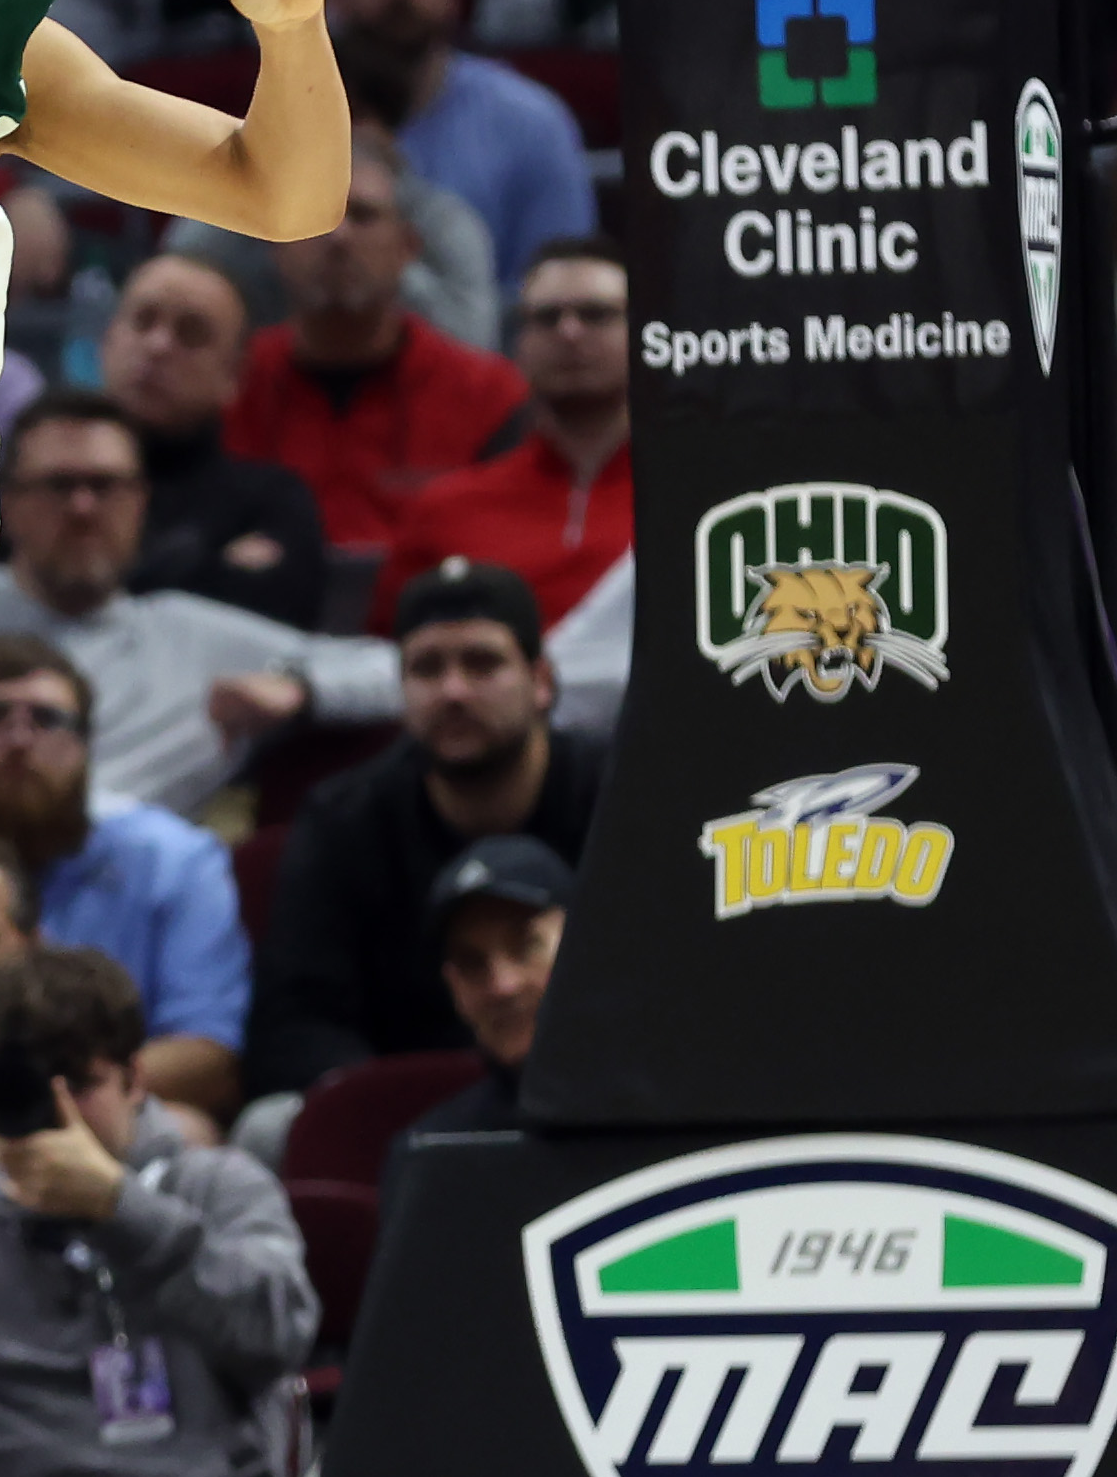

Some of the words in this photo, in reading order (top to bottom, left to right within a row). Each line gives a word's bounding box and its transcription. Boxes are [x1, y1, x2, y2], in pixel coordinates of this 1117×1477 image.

[650, 120, 989, 197] Cleveland
[724, 207, 918, 278] Clinic
[641, 320, 790, 377] Sports
[803, 311, 1011, 361] Medicine
[700, 811, 954, 919] TOLEDO
[768, 1227, 919, 1279] 1946
[594, 1329, 1095, 1466] MAC
